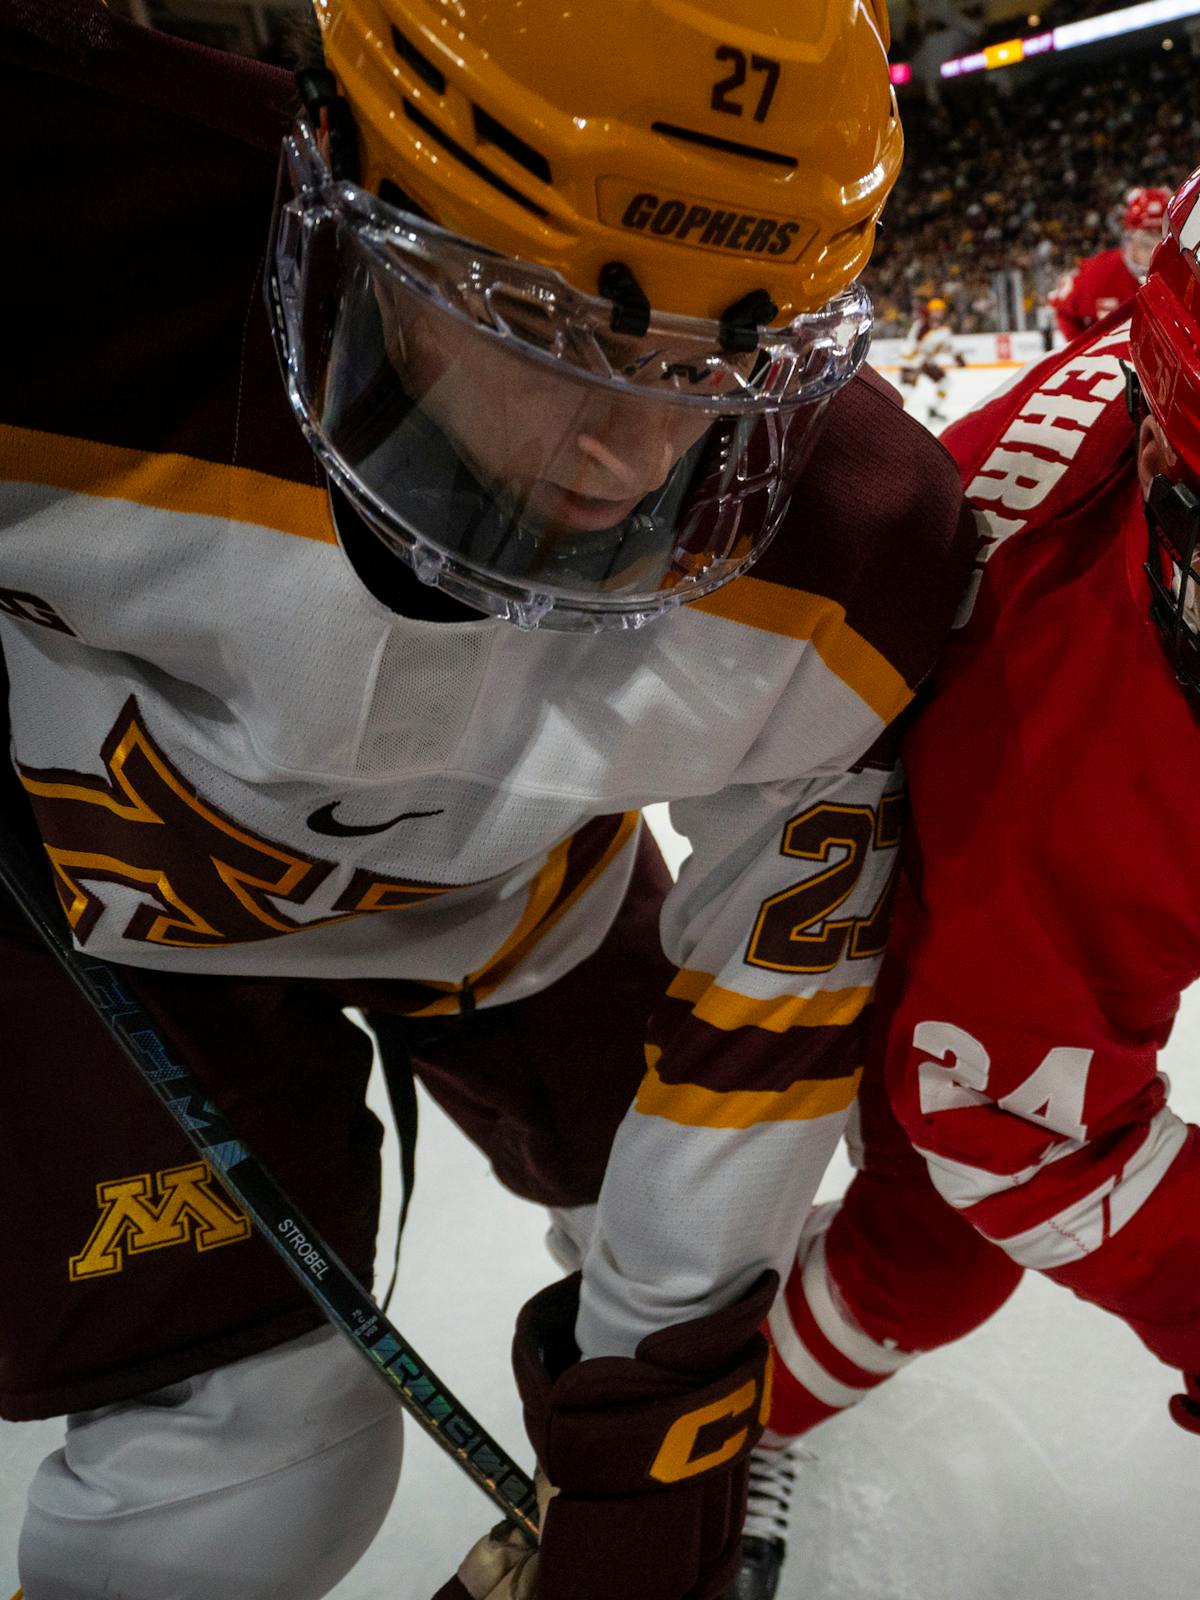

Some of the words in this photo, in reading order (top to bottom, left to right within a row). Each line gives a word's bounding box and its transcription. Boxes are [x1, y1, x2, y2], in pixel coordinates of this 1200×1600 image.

[711, 44, 781, 123] 27
[620, 193, 800, 256] GOPHERS
[912, 1021, 1094, 1142] 24
[278, 1218, 331, 1281] STROBEL
[384, 1346, 540, 1518] RIBCO
